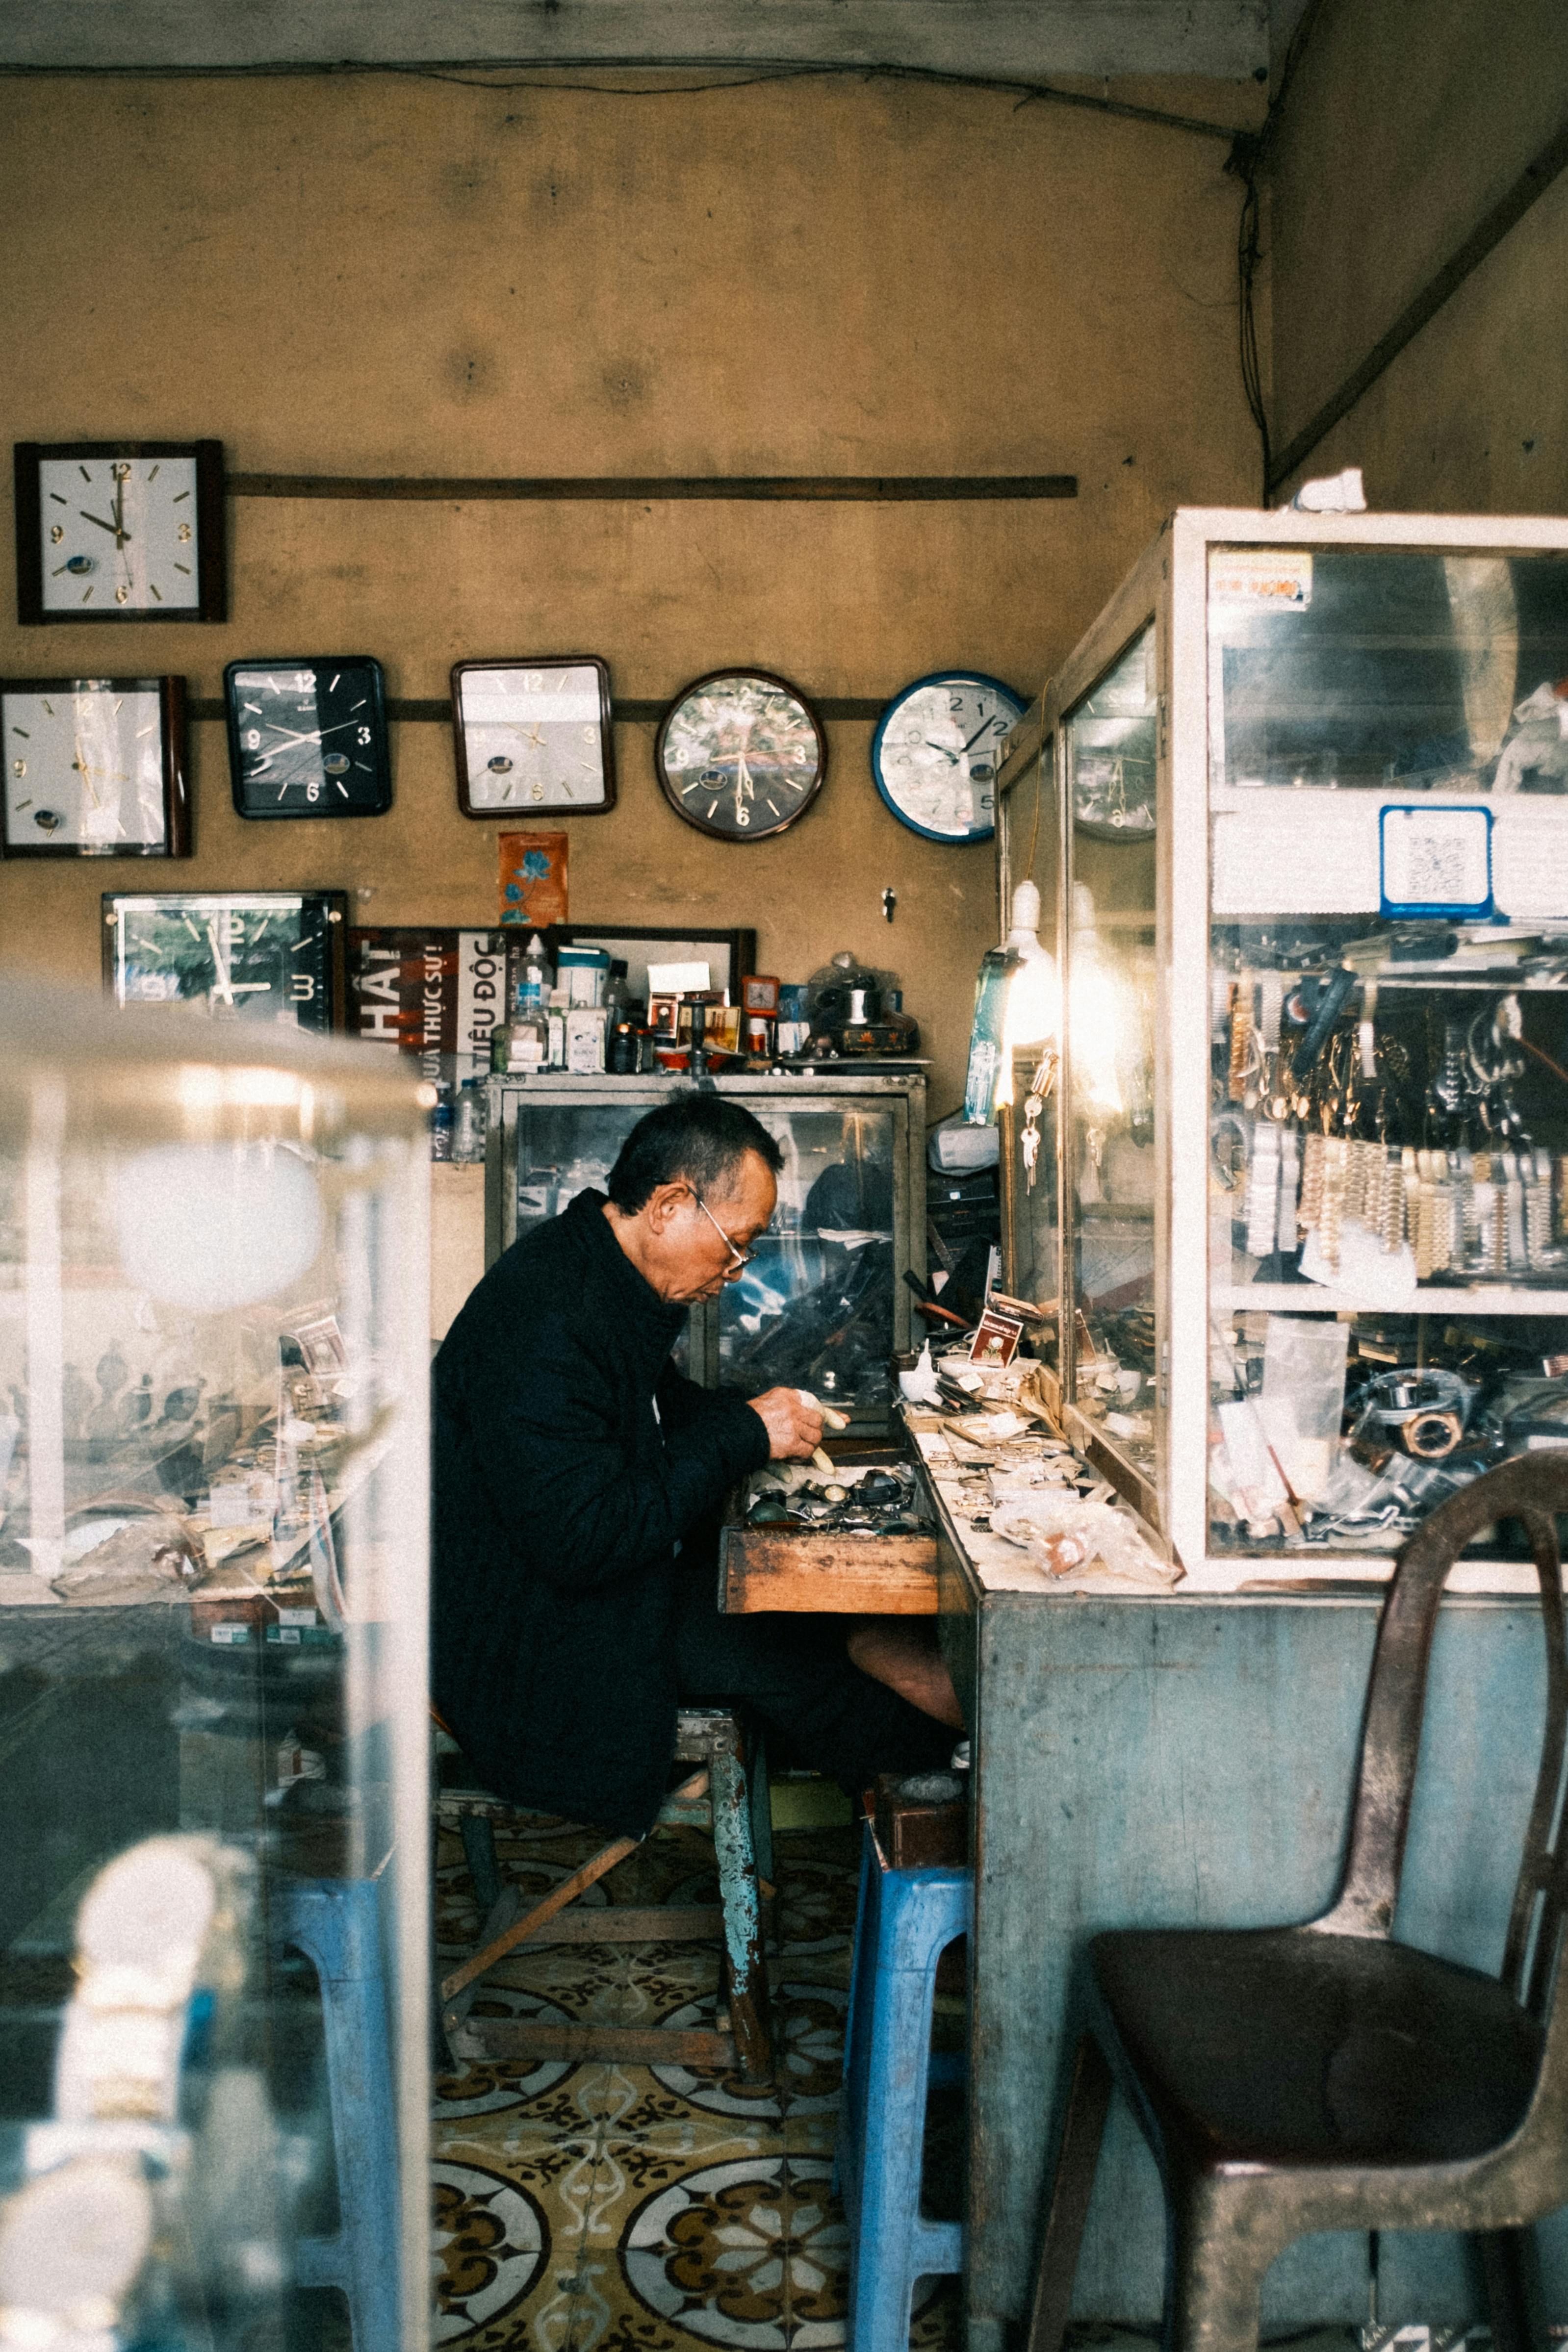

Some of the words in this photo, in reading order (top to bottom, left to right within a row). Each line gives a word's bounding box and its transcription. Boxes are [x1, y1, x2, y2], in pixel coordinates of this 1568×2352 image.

[110, 463, 131, 482] 12
[51, 525, 64, 544] 9
[179, 523, 191, 543] 3
[116, 586, 129, 605] 6
[295, 673, 317, 693] 12
[977, 703, 984, 717] 1
[358, 727, 371, 745] 3
[583, 726, 596, 744] 3
[992, 721, 1009, 736] 2
[247, 729, 261, 750] 9
[794, 745, 807, 764] 3
[307, 783, 320, 802] 6
[533, 783, 544, 801] 6
[981, 795, 994, 810] 5
[736, 806, 750, 827] 6
[290, 974, 314, 1001] 3
[422, 987, 446, 1044] THỰC
[467, 1008, 496, 1068] TIÊU
